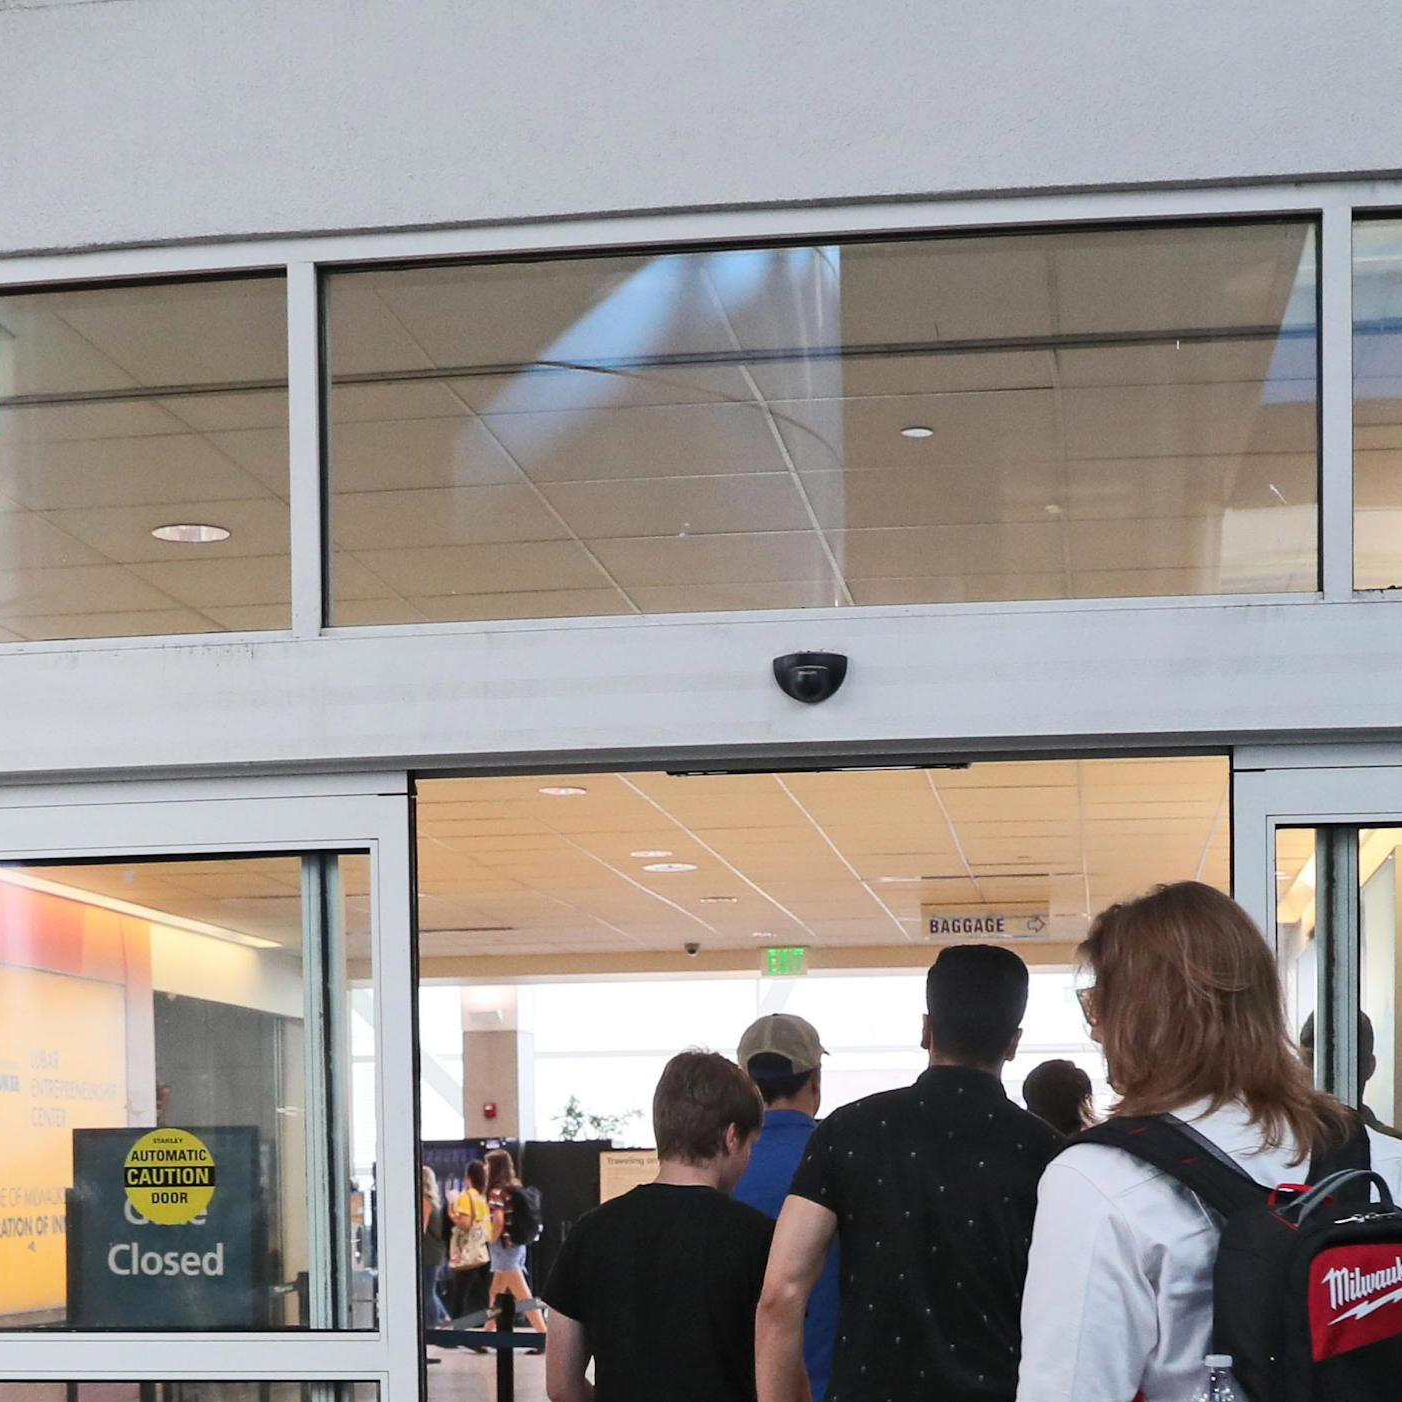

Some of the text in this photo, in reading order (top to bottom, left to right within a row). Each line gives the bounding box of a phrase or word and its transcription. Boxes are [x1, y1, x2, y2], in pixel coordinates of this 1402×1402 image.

[929, 916, 1005, 934] BAGGAGE
[767, 948, 804, 974] EXIT
[131, 1150, 206, 1161] AUTOMATIC
[127, 1168, 209, 1185] CAUTION
[152, 1192, 188, 1204] DOOR
[36, 1215, 48, 1235] OF
[108, 1242, 224, 1276] Closed
